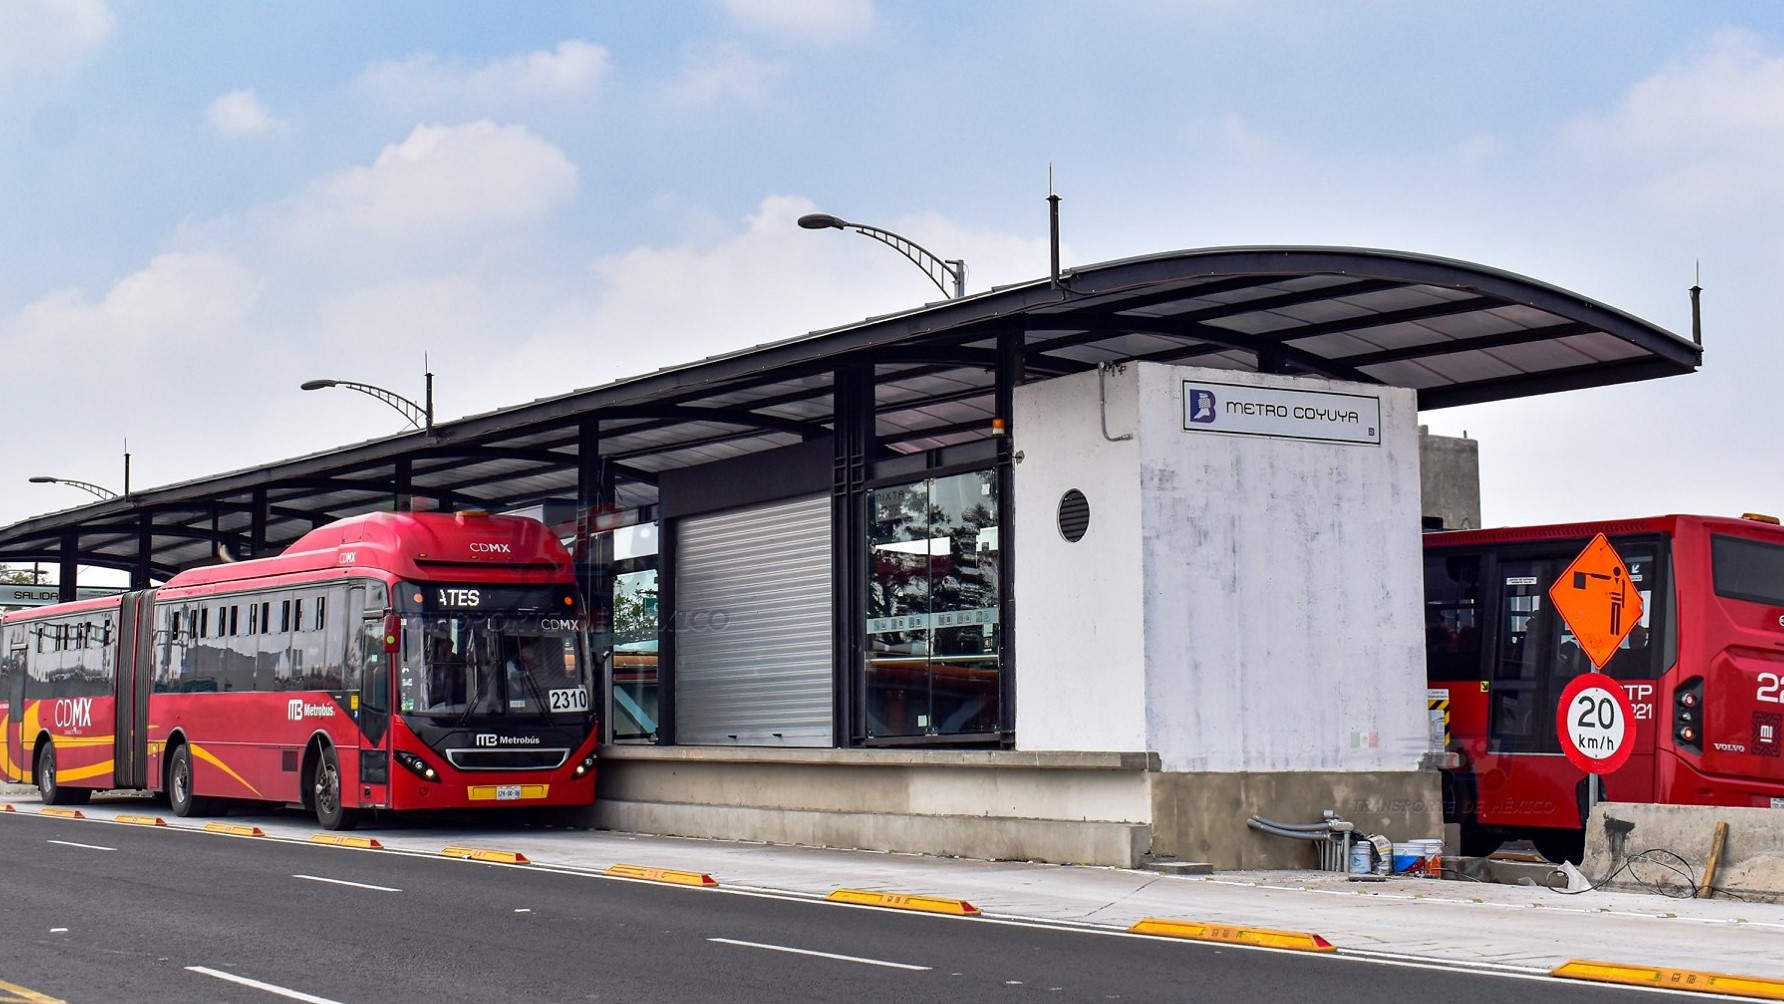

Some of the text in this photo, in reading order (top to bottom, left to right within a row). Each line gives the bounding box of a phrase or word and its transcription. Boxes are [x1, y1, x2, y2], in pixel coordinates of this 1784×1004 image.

[1226, 401, 1359, 424] METRO COYUYA
[470, 543, 511, 553] CDMX
[338, 552, 357, 564] CDMX
[14, 591, 59, 601] SALIDA
[541, 618, 579, 631] CDMX
[551, 690, 587, 710] 2310
[1620, 685, 1653, 700] TP
[55, 698, 92, 727] CDMX
[304, 702, 334, 717] Metrobús
[1577, 695, 1615, 730] 20
[500, 735, 540, 745] Metrobús
[1578, 733, 1614, 751] km/h
[1713, 742, 1746, 753] VOLVO
